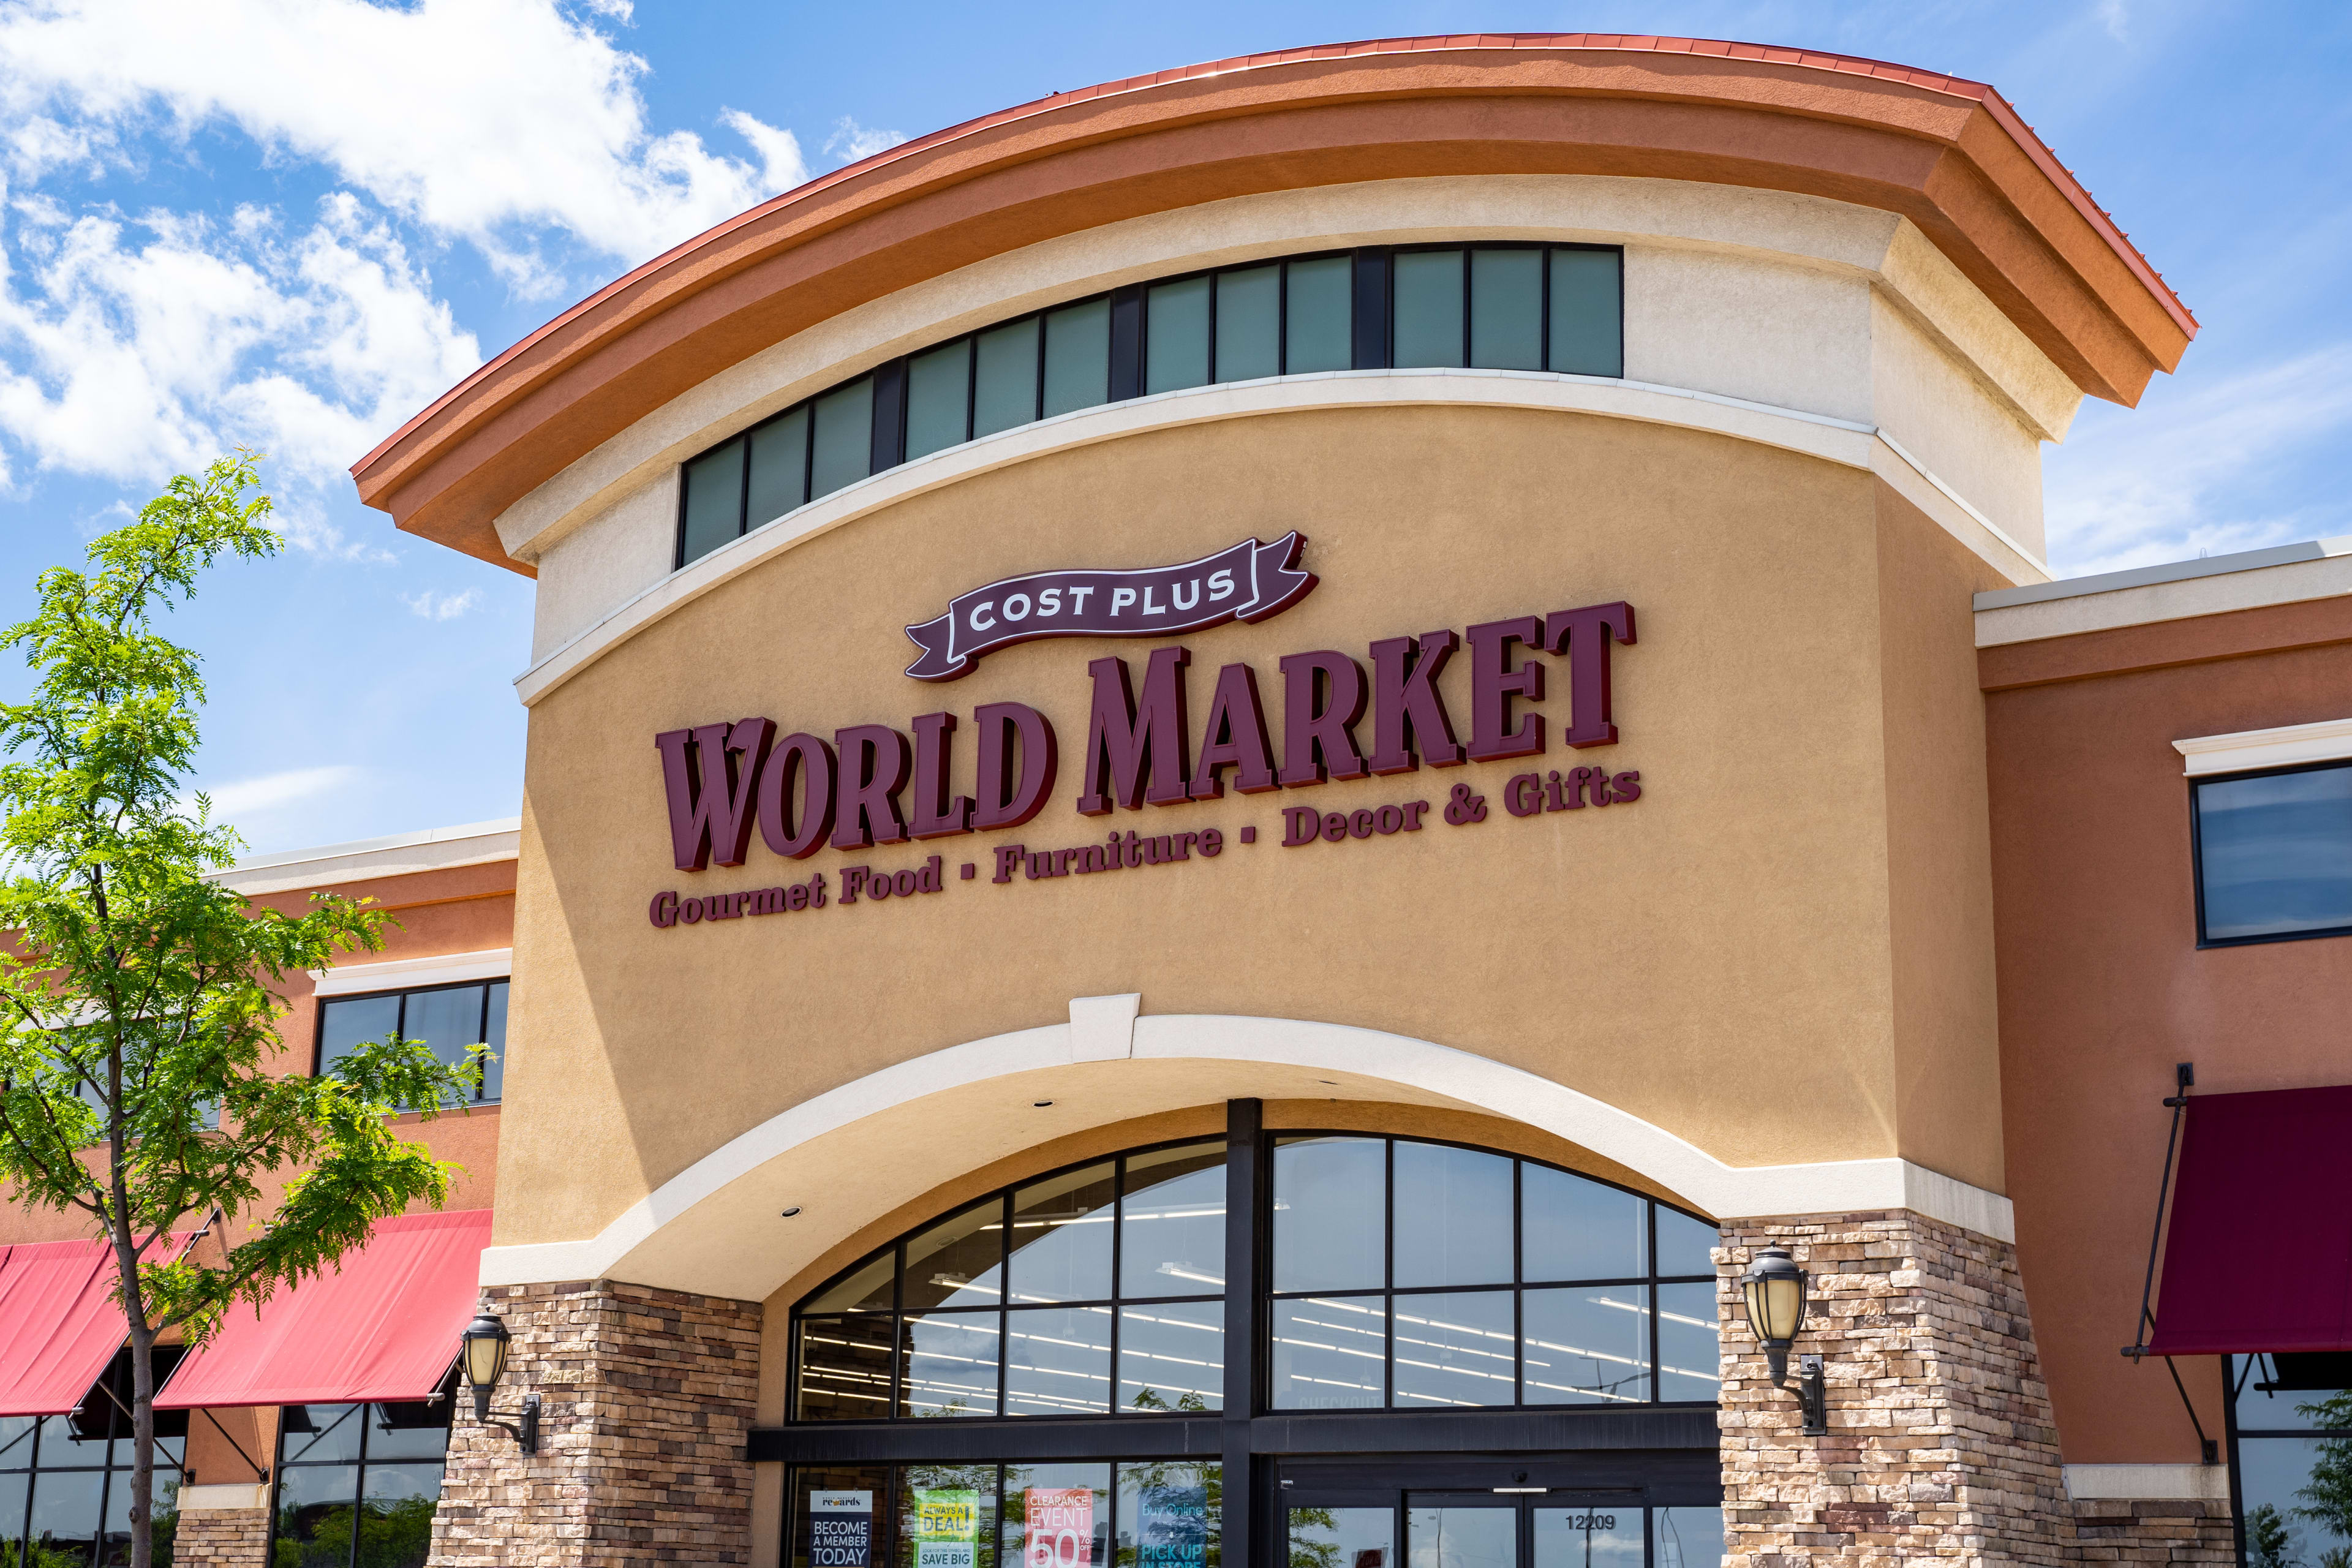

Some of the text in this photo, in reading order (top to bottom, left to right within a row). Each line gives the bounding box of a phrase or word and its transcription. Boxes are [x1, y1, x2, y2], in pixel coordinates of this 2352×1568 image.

[969, 568, 1235, 631] COST PLUS
[655, 601, 1637, 873] WORLD MARKET
[649, 766, 1642, 929] Gourmet Food Furniture Decor & Gifts
[1030, 1496, 1087, 1506] CLEARANCE
[924, 1506, 970, 1531] DEAL!
[1031, 1507, 1088, 1526] EVENT
[1142, 1502, 1203, 1520] Buy Online
[814, 1521, 867, 1535] BECOME
[1566, 1515, 1616, 1530] 12209
[813, 1536, 867, 1546] A MEMBER
[813, 1548, 867, 1565] TODAY
[922, 1554, 970, 1565] SAVE BIG
[1142, 1544, 1202, 1559] PICK UP
